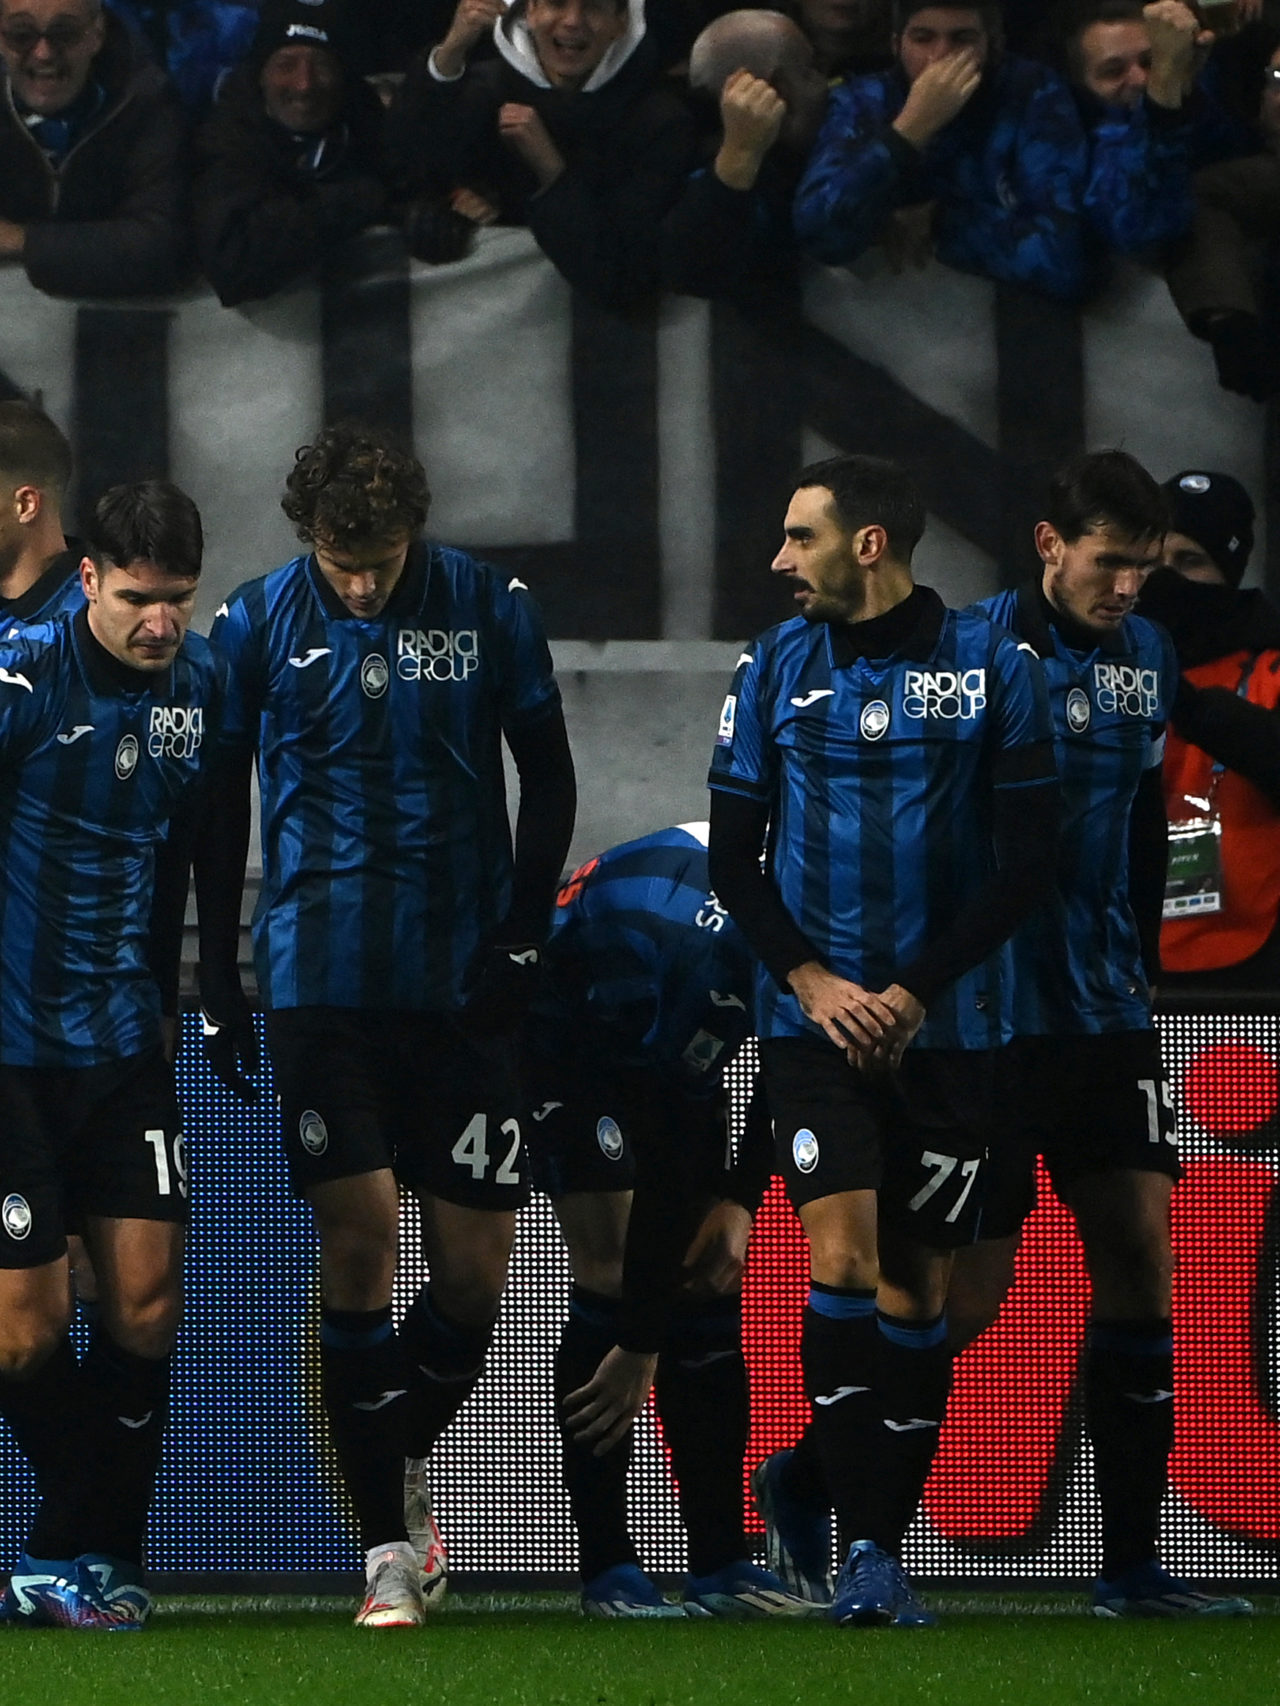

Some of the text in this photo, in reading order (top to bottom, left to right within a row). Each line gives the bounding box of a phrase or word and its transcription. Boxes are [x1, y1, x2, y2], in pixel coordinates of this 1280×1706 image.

[396, 628, 479, 656] RADICI
[395, 655, 480, 682] GROUP
[903, 667, 986, 697] RADICI
[1093, 663, 1158, 697] RADICI
[902, 694, 987, 721] GROUP
[1096, 688, 1159, 718] GROUP
[148, 705, 203, 735] RADICI
[147, 732, 202, 759] GROUP
[1137, 1079, 1179, 1147] 15
[450, 1112, 521, 1185] 42
[144, 1129, 189, 1199] 19
[908, 1149, 982, 1224] 77
